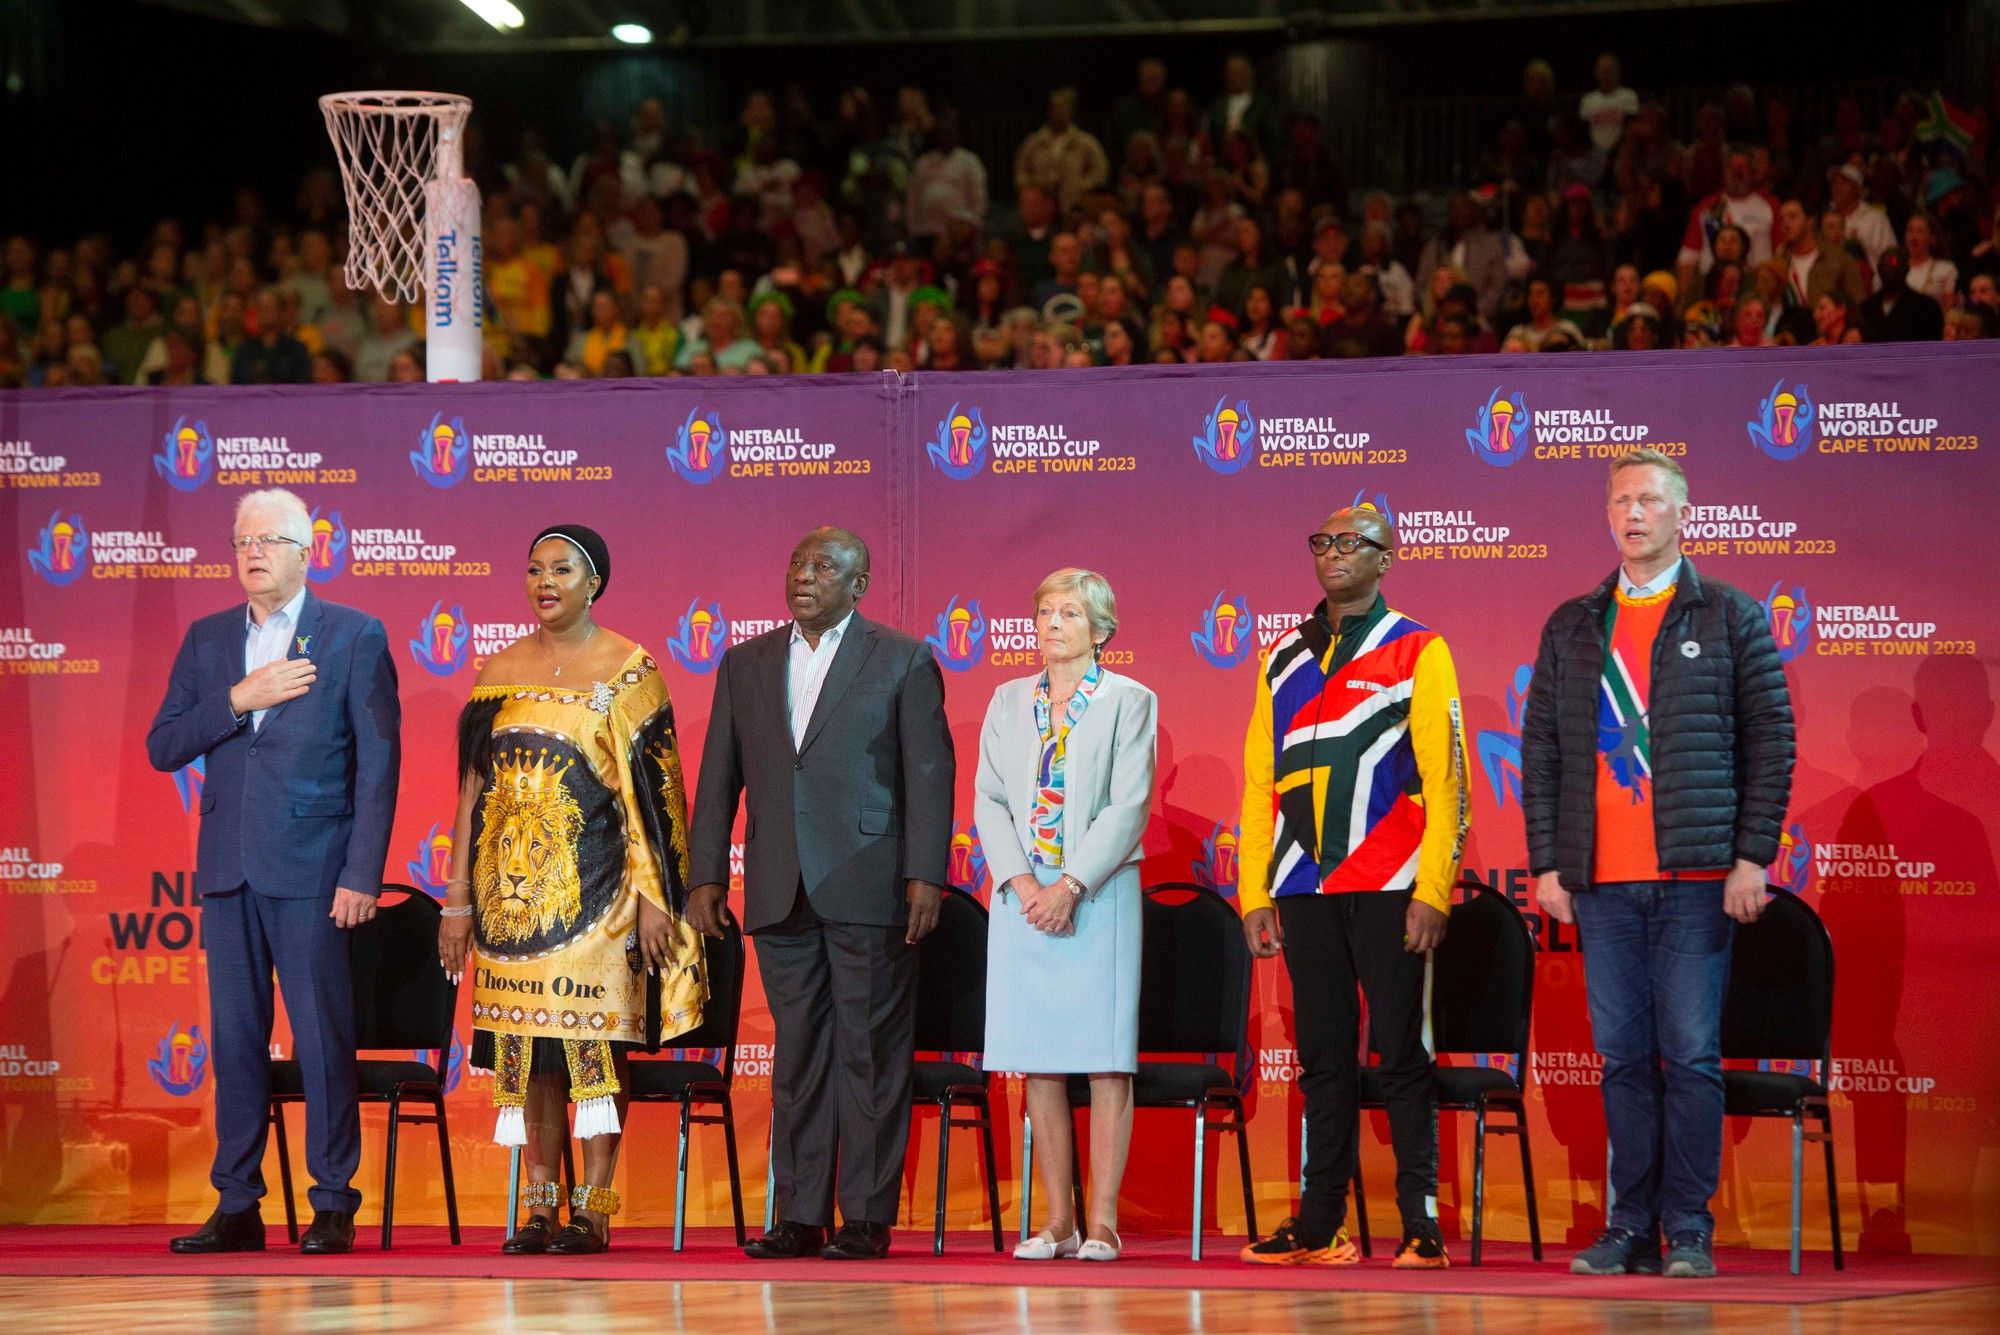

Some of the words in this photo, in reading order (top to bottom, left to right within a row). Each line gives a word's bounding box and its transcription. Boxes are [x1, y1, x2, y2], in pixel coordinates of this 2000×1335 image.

[1534, 409, 1614, 425] NETBALL
[1818, 402, 1901, 419] NETBALL
[992, 424, 1067, 441] NETBALL
[1259, 417, 1336, 434] NETBALL
[1534, 427, 1606, 443] WORLD
[1609, 425, 1649, 441] CUP
[1818, 420, 1894, 437] WORLD
[1896, 418, 1938, 435] CUP
[217, 437, 290, 453] NETBALL
[473, 434, 545, 450] NETBALL
[730, 428, 803, 445] NETBALL
[1259, 434, 1329, 451] WORLD
[1332, 433, 1370, 449] CUP
[1818, 438, 1867, 453] CAPE
[1871, 437, 1930, 452] TOWN
[1934, 435, 1978, 451] 2023
[730, 445, 796, 462] WORLD
[799, 444, 835, 460] CUP
[992, 440, 1060, 457] WORLD
[1063, 440, 1100, 456] CUP
[1534, 445, 1581, 460] CAPE
[29, 456, 66, 472] CUP
[217, 454, 283, 470] WORLD
[286, 453, 322, 468] CUP
[473, 451, 539, 467] WORLD
[541, 450, 577, 466] CUP
[992, 459, 1036, 474] CAPE
[1040, 457, 1093, 473] TOWN
[1097, 456, 1136, 471] 2023
[1259, 452, 1304, 467] CAPE
[1308, 450, 1363, 466] TOWN
[1367, 449, 1407, 464] 2023
[217, 470, 260, 485] CAPE
[264, 469, 315, 484] TOWN
[319, 468, 357, 483] 2023
[473, 467, 516, 483] CAPE
[519, 466, 570, 481] TOWN
[574, 466, 612, 481] 2023
[730, 461, 773, 478] CAPE
[777, 460, 828, 476] TOWN
[832, 459, 870, 474] 2023
[9, 473, 60, 488] TOWN
[63, 472, 101, 487] 2023
[1398, 510, 1475, 527] NETBALL
[91, 531, 164, 547] NETBALL
[351, 528, 423, 545] NETBALL
[1398, 528, 1468, 544] WORLD
[1471, 526, 1510, 542] CUP
[1682, 523, 1755, 539] WORLD
[1756, 522, 1797, 537] CUP
[91, 547, 157, 564] WORLD
[160, 547, 196, 563] CUP
[351, 544, 417, 561] WORLD
[419, 544, 455, 560] CUP
[1398, 546, 1444, 560] CAPE
[1448, 545, 1502, 559] TOWN
[1506, 544, 1547, 558] 2023
[1680, 541, 1728, 555] CAPE
[1732, 541, 1789, 554] TOWN
[1793, 540, 1836, 554] 2023
[91, 563, 134, 579] CAPE
[138, 563, 189, 578] TOWN
[193, 563, 232, 578] 2023
[351, 561, 394, 577] CAPE
[397, 561, 448, 576] TOWN
[452, 560, 490, 576] 2023
[1816, 606, 1899, 622] NETBALL
[990, 618, 1038, 633] NETB
[1816, 622, 1892, 640] WORLD
[1894, 622, 1936, 638] CUP
[29, 643, 65, 659] CUP
[1816, 641, 1865, 656] CAPE
[1869, 641, 1928, 655] TOWN
[1932, 640, 1976, 654] 2023
[8, 660, 58, 674] TOWN
[62, 659, 99, 674] 2023
[991, 652, 1036, 666] CAPE
[1098, 651, 1134, 664] 2023
[1346, 680, 1366, 689] CAPE
[1815, 844, 1899, 860] NETBALL
[27, 863, 64, 878] CUP
[1816, 861, 1891, 877] WORLD
[1895, 862, 1936, 878] CUP
[1933, 881, 1977, 895] 2023
[91, 956, 191, 985] CAPE
[474, 967, 544, 995] Chosen
[552, 975, 607, 999] One
[24, 1061, 61, 1076] CUP
[734, 1079, 768, 1091] APE
[1532, 1069, 1604, 1086] WORLD
[1895, 1077, 1936, 1094] CUP
